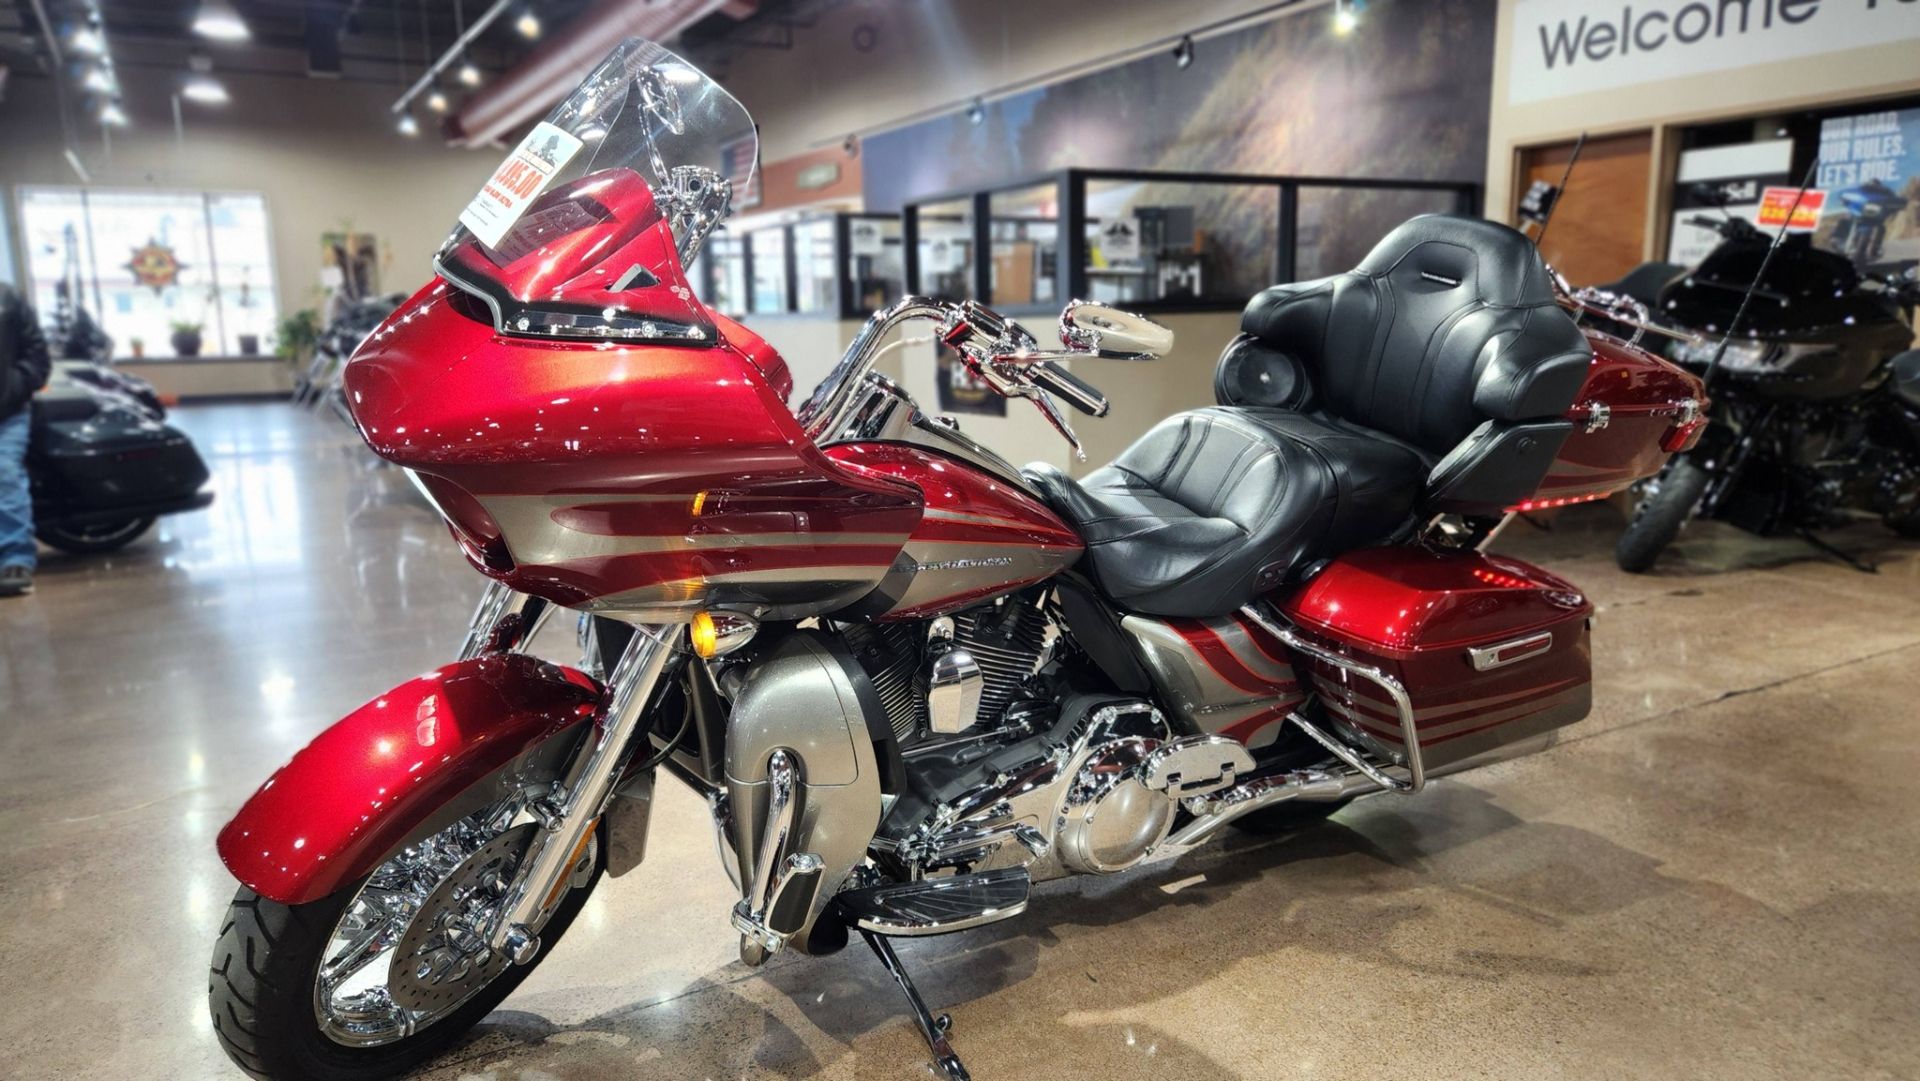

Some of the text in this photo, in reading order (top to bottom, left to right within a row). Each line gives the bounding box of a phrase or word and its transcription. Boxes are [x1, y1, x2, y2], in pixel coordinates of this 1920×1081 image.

[1539, 0, 1820, 70] Welcome
[1819, 134, 1907, 163] OUR RULES.
[1816, 159, 1901, 188] LET'S RIDE.
